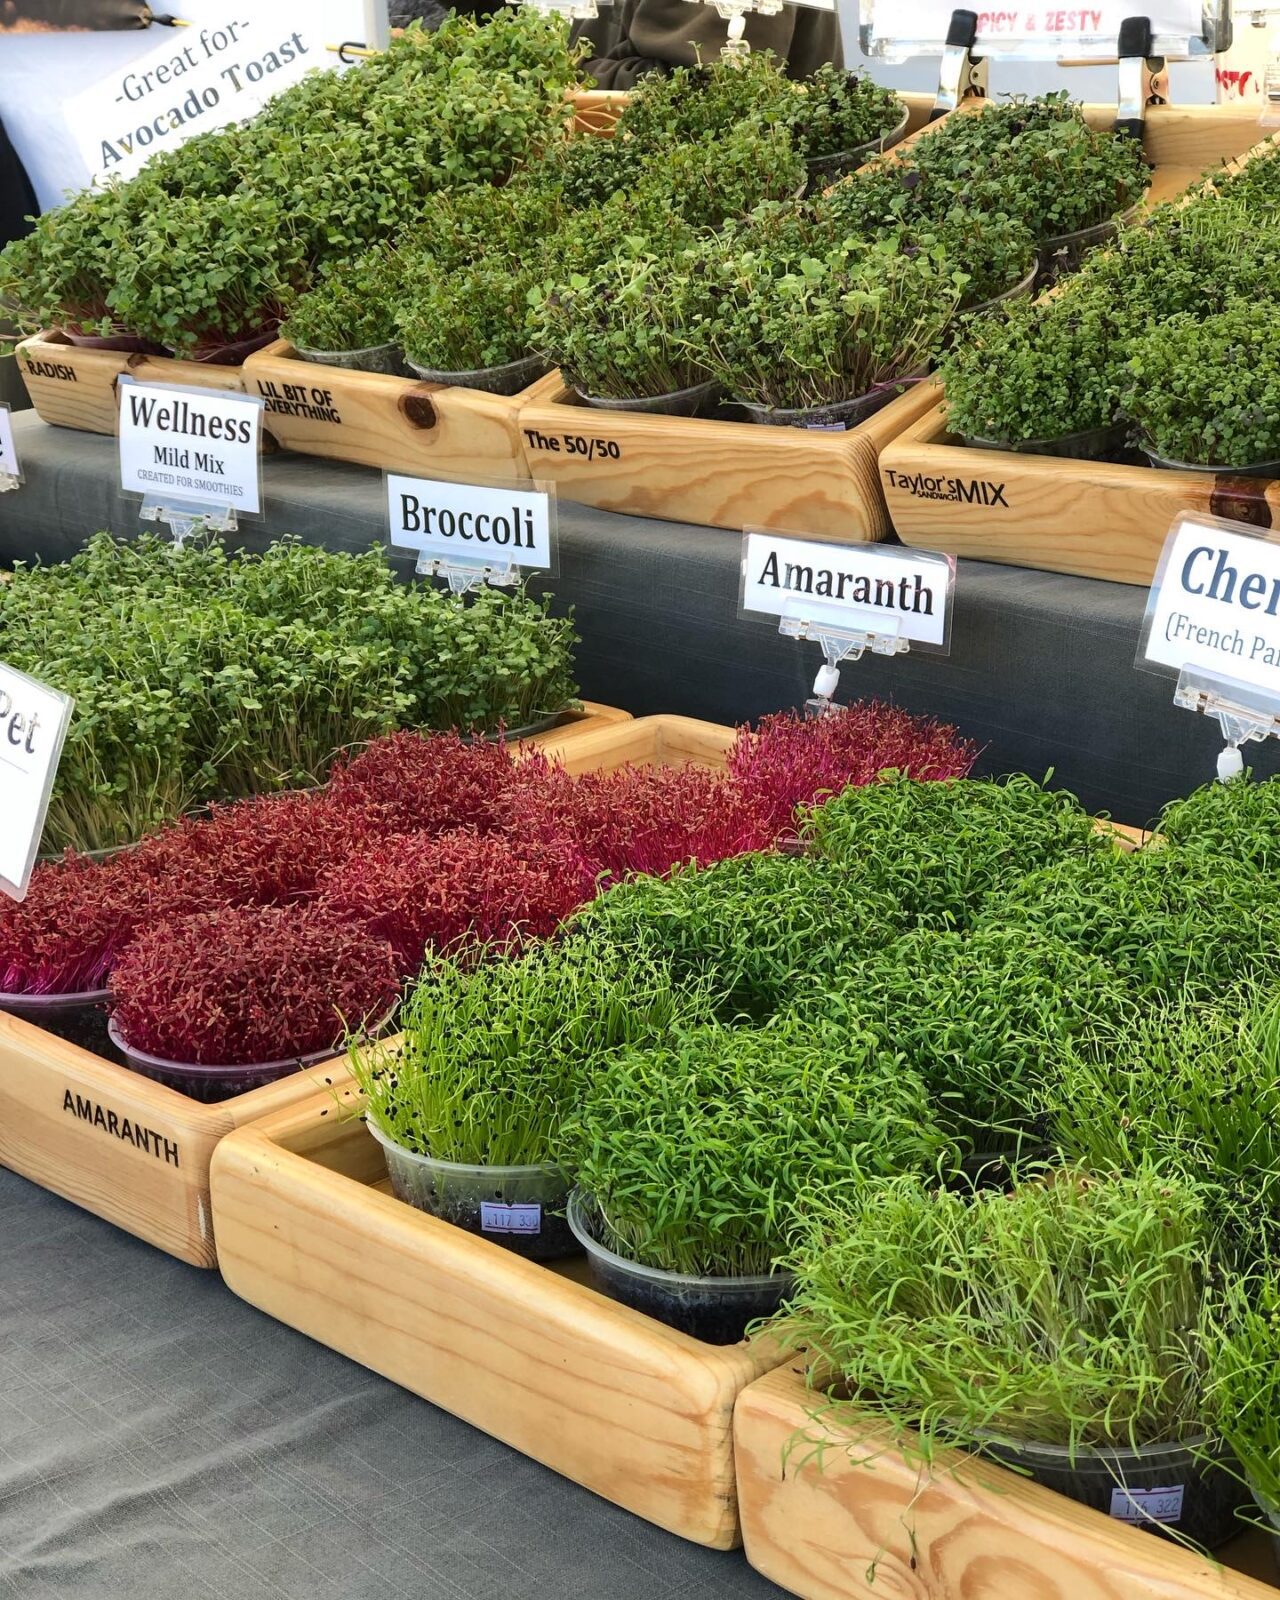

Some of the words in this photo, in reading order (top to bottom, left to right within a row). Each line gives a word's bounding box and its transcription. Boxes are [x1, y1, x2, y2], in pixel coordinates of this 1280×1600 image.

[976, 11, 1018, 33] PICY
[1045, 9, 1102, 32] ZESTY
[114, 48, 198, 104] -Great
[199, 19, 250, 59] for-
[100, 86, 220, 169] Avocado
[221, 31, 309, 93] Toast
[26, 359, 77, 383] RADISH
[257, 379, 283, 400] LIL
[282, 383, 307, 404] BIT
[311, 388, 334, 408] OF
[129, 395, 251, 444] Wellness
[264, 397, 342, 425] EVERYTHING
[153, 445, 190, 470] Mild
[194, 452, 226, 476] Mix
[524, 429, 560, 452] The
[564, 434, 621, 462] 50/50
[137, 469, 175, 485] CREATED
[176, 475, 194, 489] FOR
[194, 478, 244, 497] SMOOTHIES
[917, 489, 958, 502] SANDWICH
[400, 493, 536, 549] Broccoli
[757, 551, 934, 616] Amaranth
[1165, 611, 1244, 656] (French
[63, 1088, 179, 1168] AMARANTH
